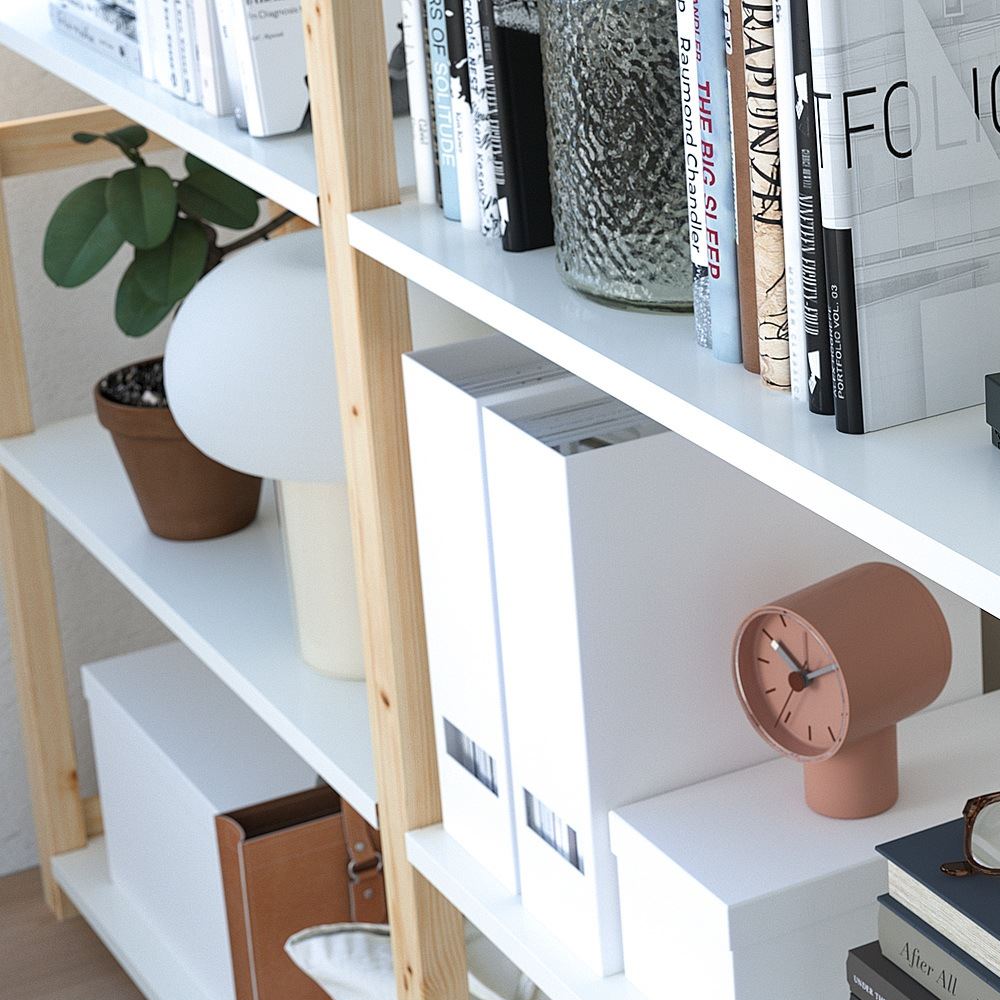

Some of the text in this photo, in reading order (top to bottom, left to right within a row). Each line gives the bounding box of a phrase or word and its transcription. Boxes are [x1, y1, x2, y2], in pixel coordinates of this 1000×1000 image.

[431, 27, 446, 56] OF
[433, 62, 456, 167] SOLITUDE
[698, 81, 712, 133] THE
[742, 1, 783, 229] RAPUNZEL
[701, 140, 716, 186] BIG
[687, 154, 703, 254] Chandler
[831, 285, 838, 299] 03
[834, 329, 845, 399] PORTFOLIO
[853, 974, 874, 997] UNDER
[900, 942, 958, 997] After All
